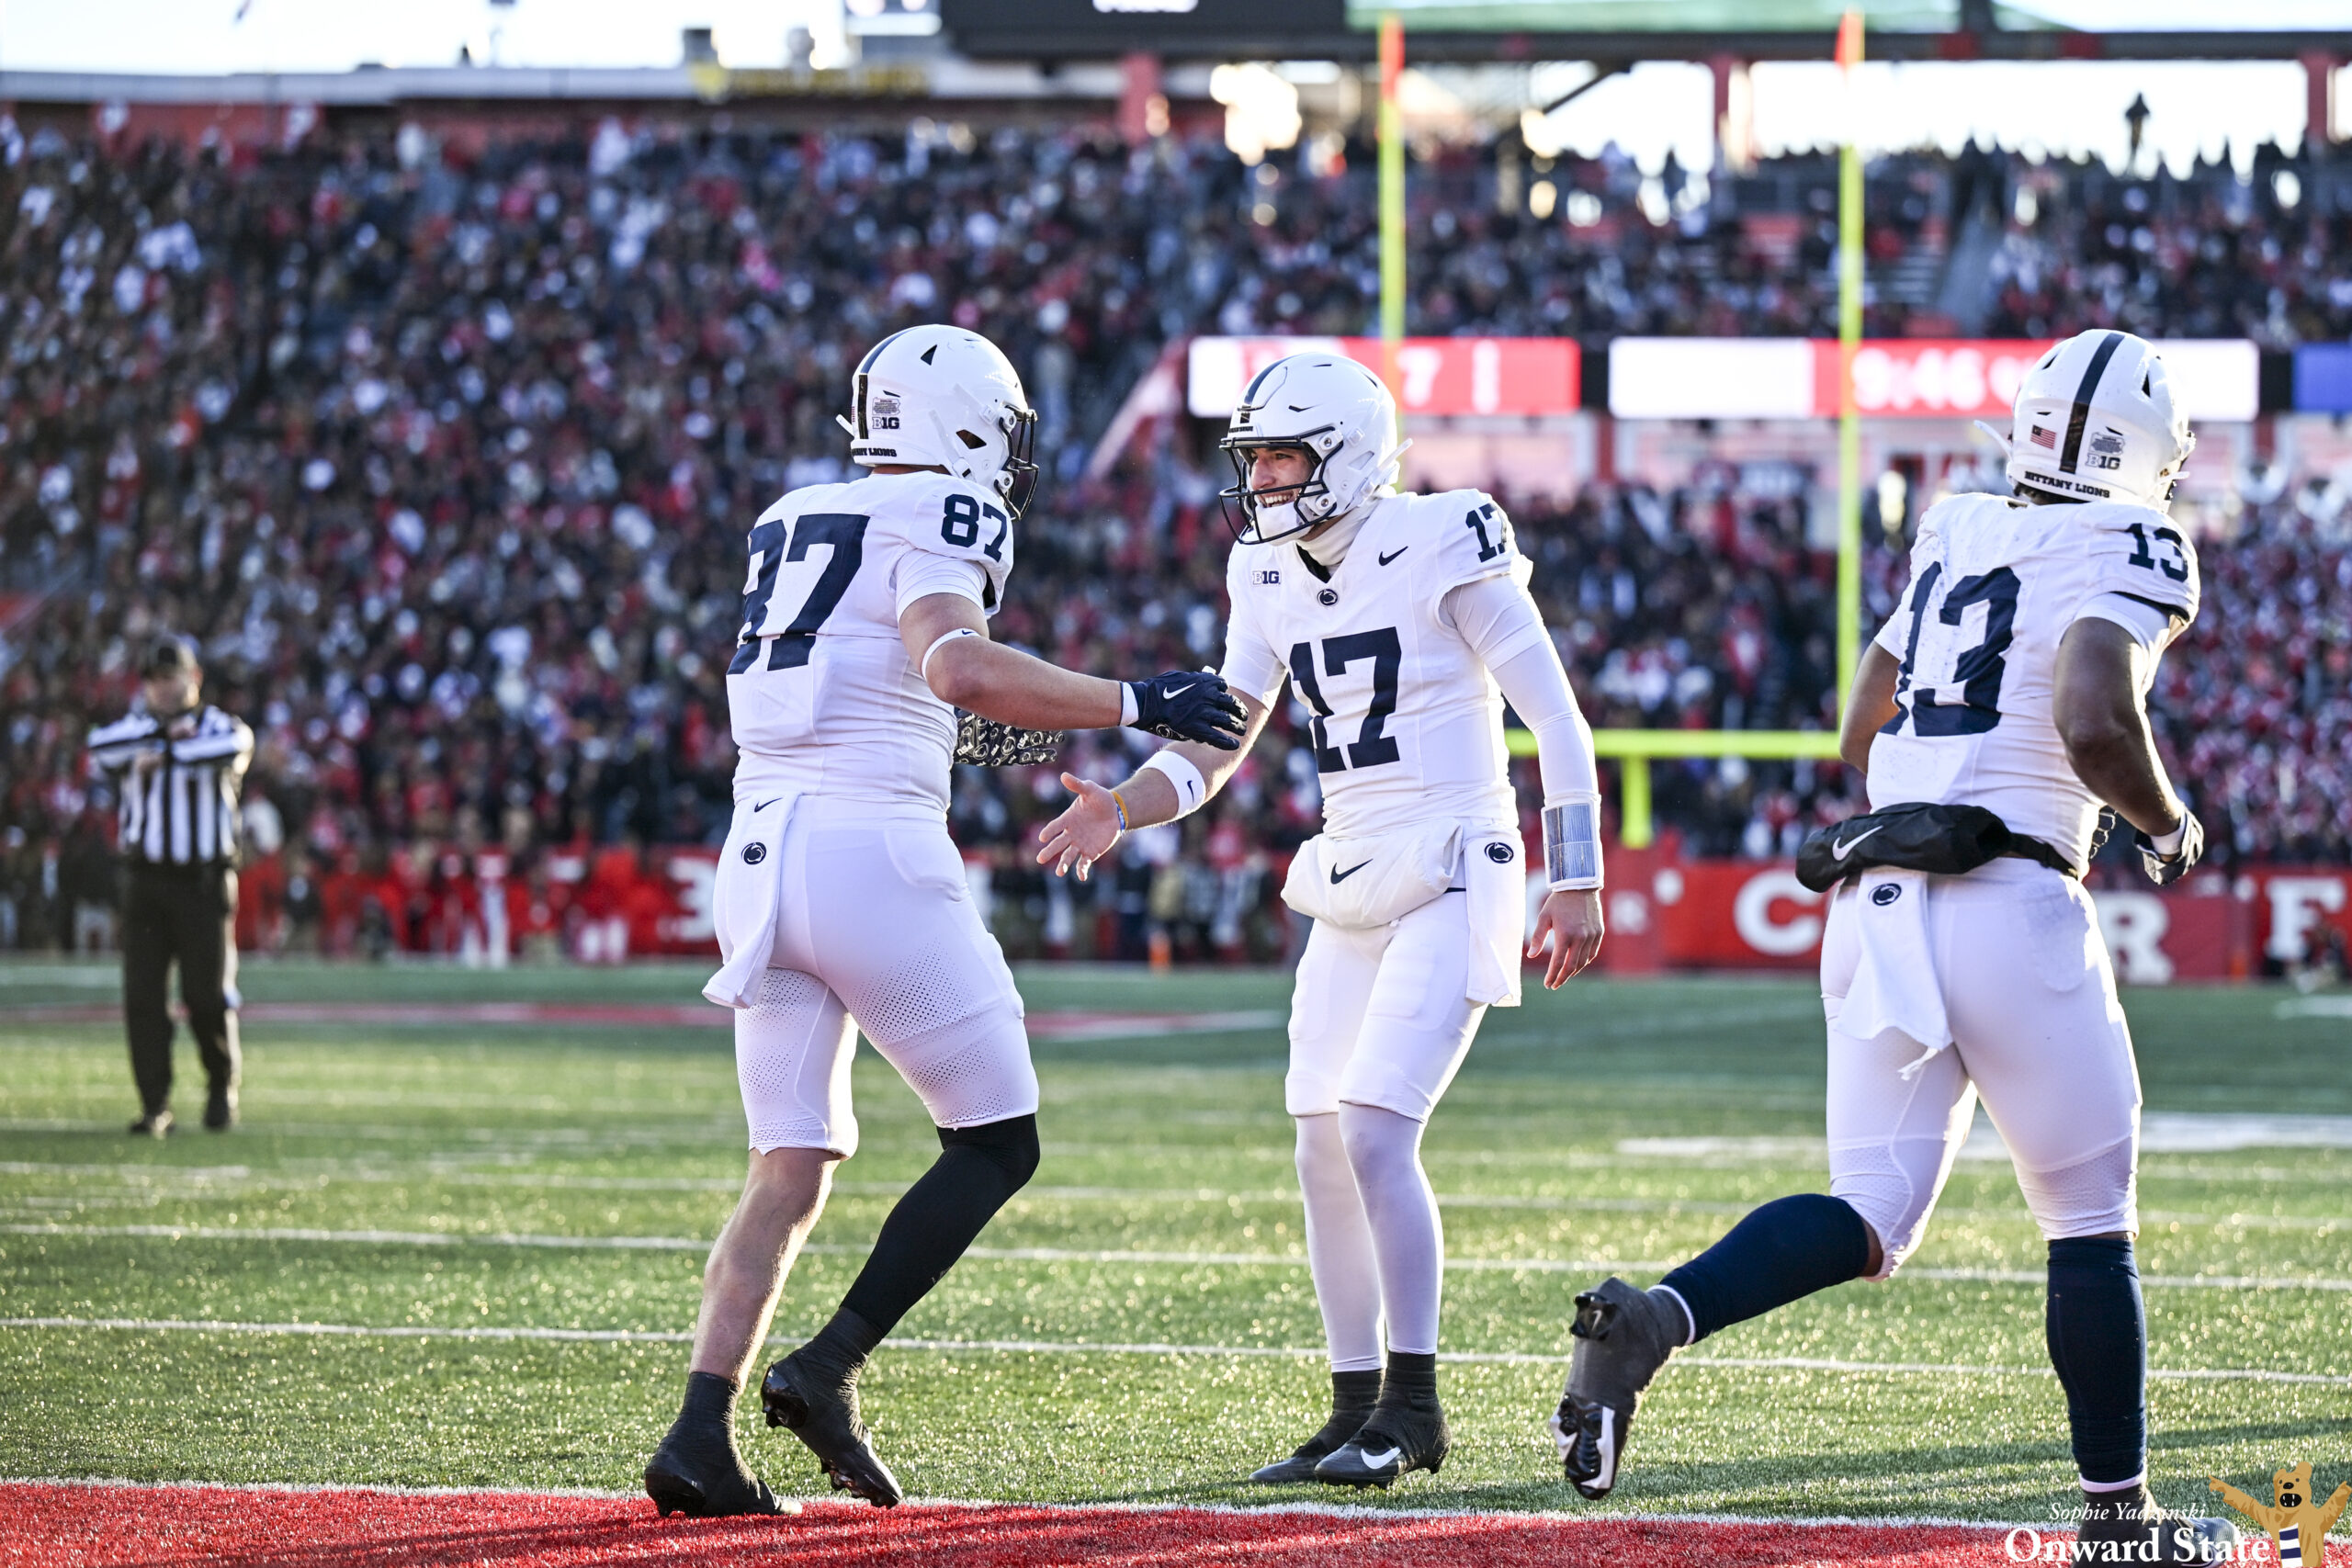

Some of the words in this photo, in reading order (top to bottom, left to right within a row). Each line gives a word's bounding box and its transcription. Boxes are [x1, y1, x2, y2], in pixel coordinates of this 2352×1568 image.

[2075, 483, 2110, 498] LIONS
[941, 493, 1008, 562] 87
[2126, 522, 2188, 583] 13
[1878, 560, 2021, 738] 13
[1289, 626, 1402, 773] 17
